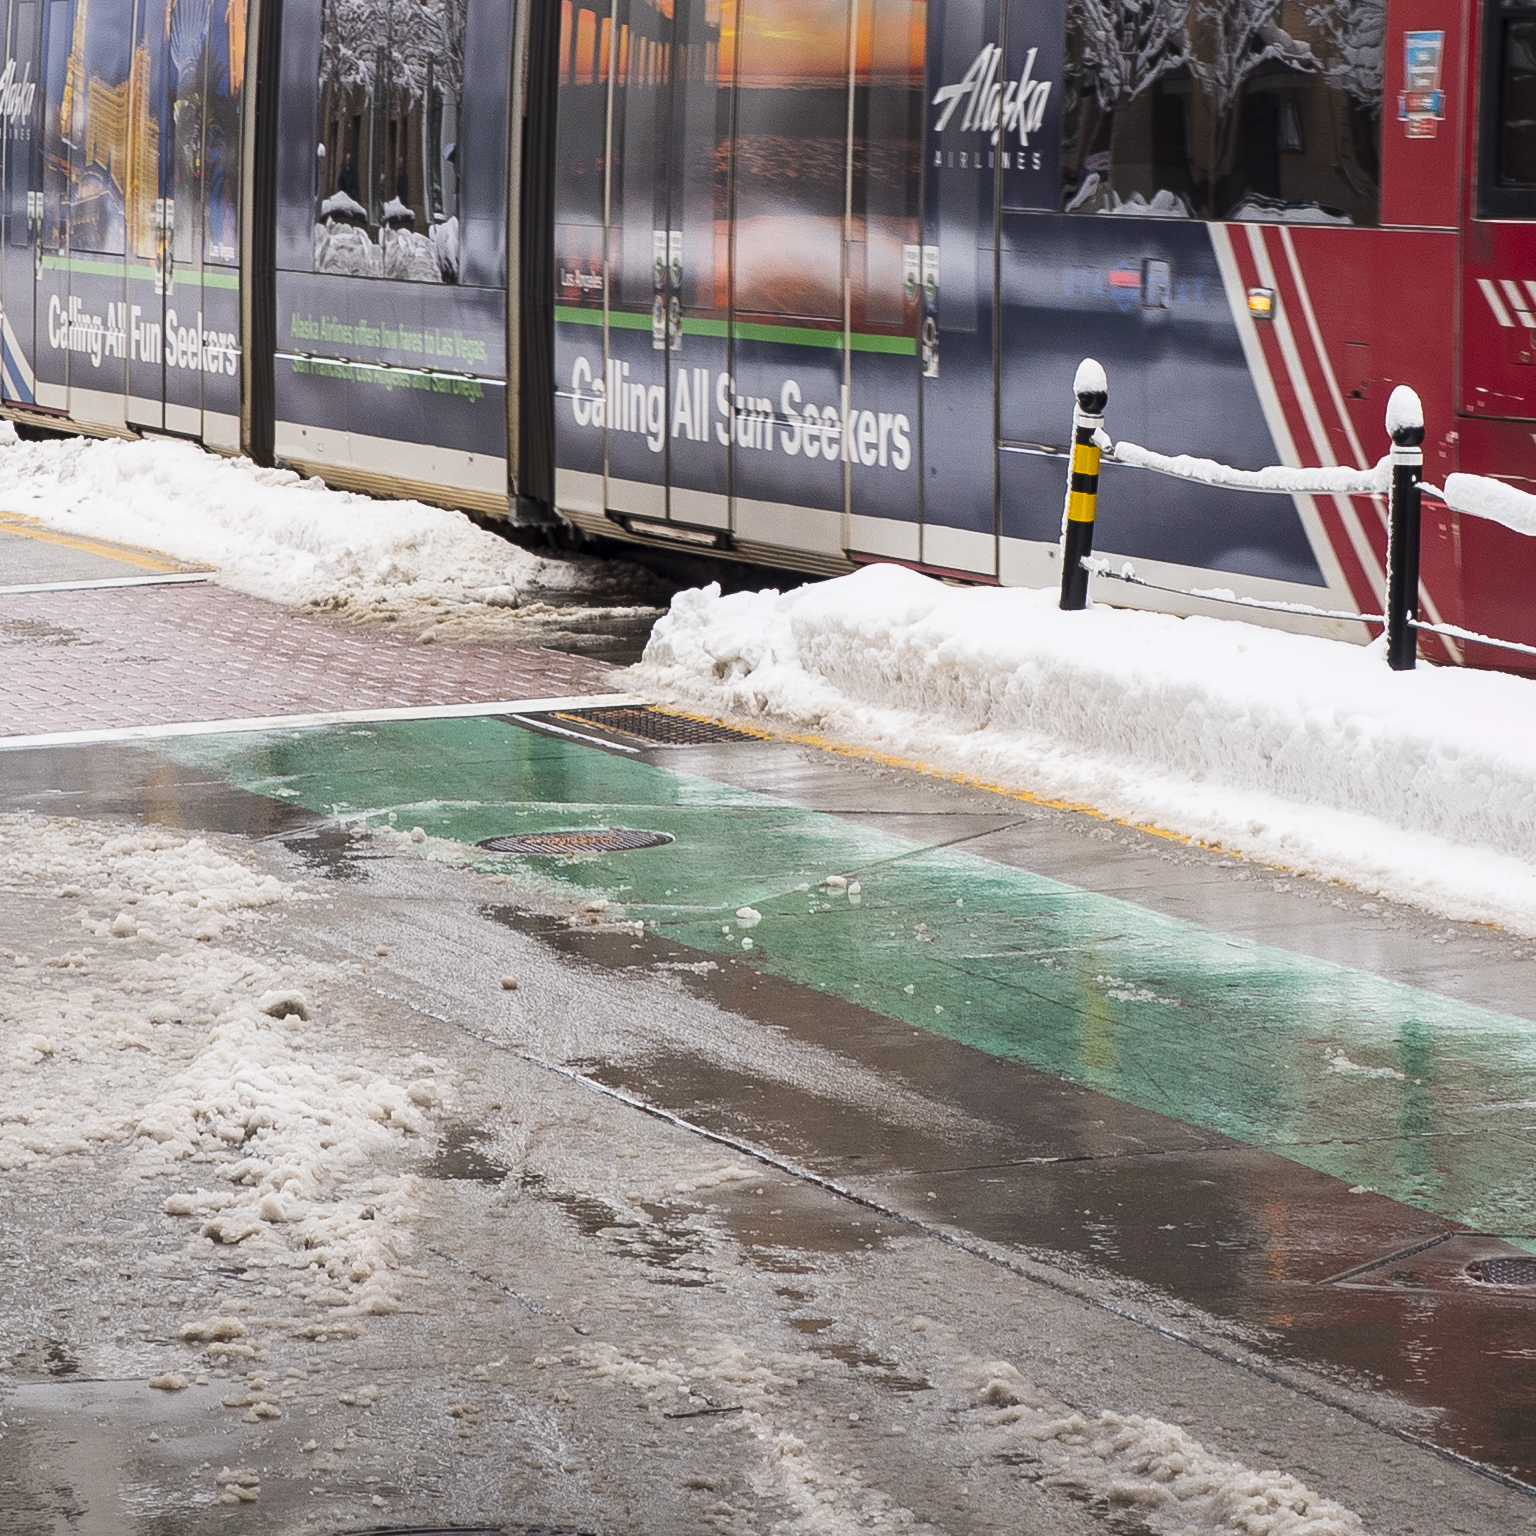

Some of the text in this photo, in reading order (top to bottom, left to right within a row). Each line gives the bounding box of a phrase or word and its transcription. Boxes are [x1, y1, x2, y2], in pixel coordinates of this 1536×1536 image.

[931, 42, 1053, 147] Alaska
[933, 150, 1042, 170] AIRLINES
[48, 294, 236, 376] Calling All Fun Seekers
[572, 356, 911, 471] Calling All Sun Seekers
